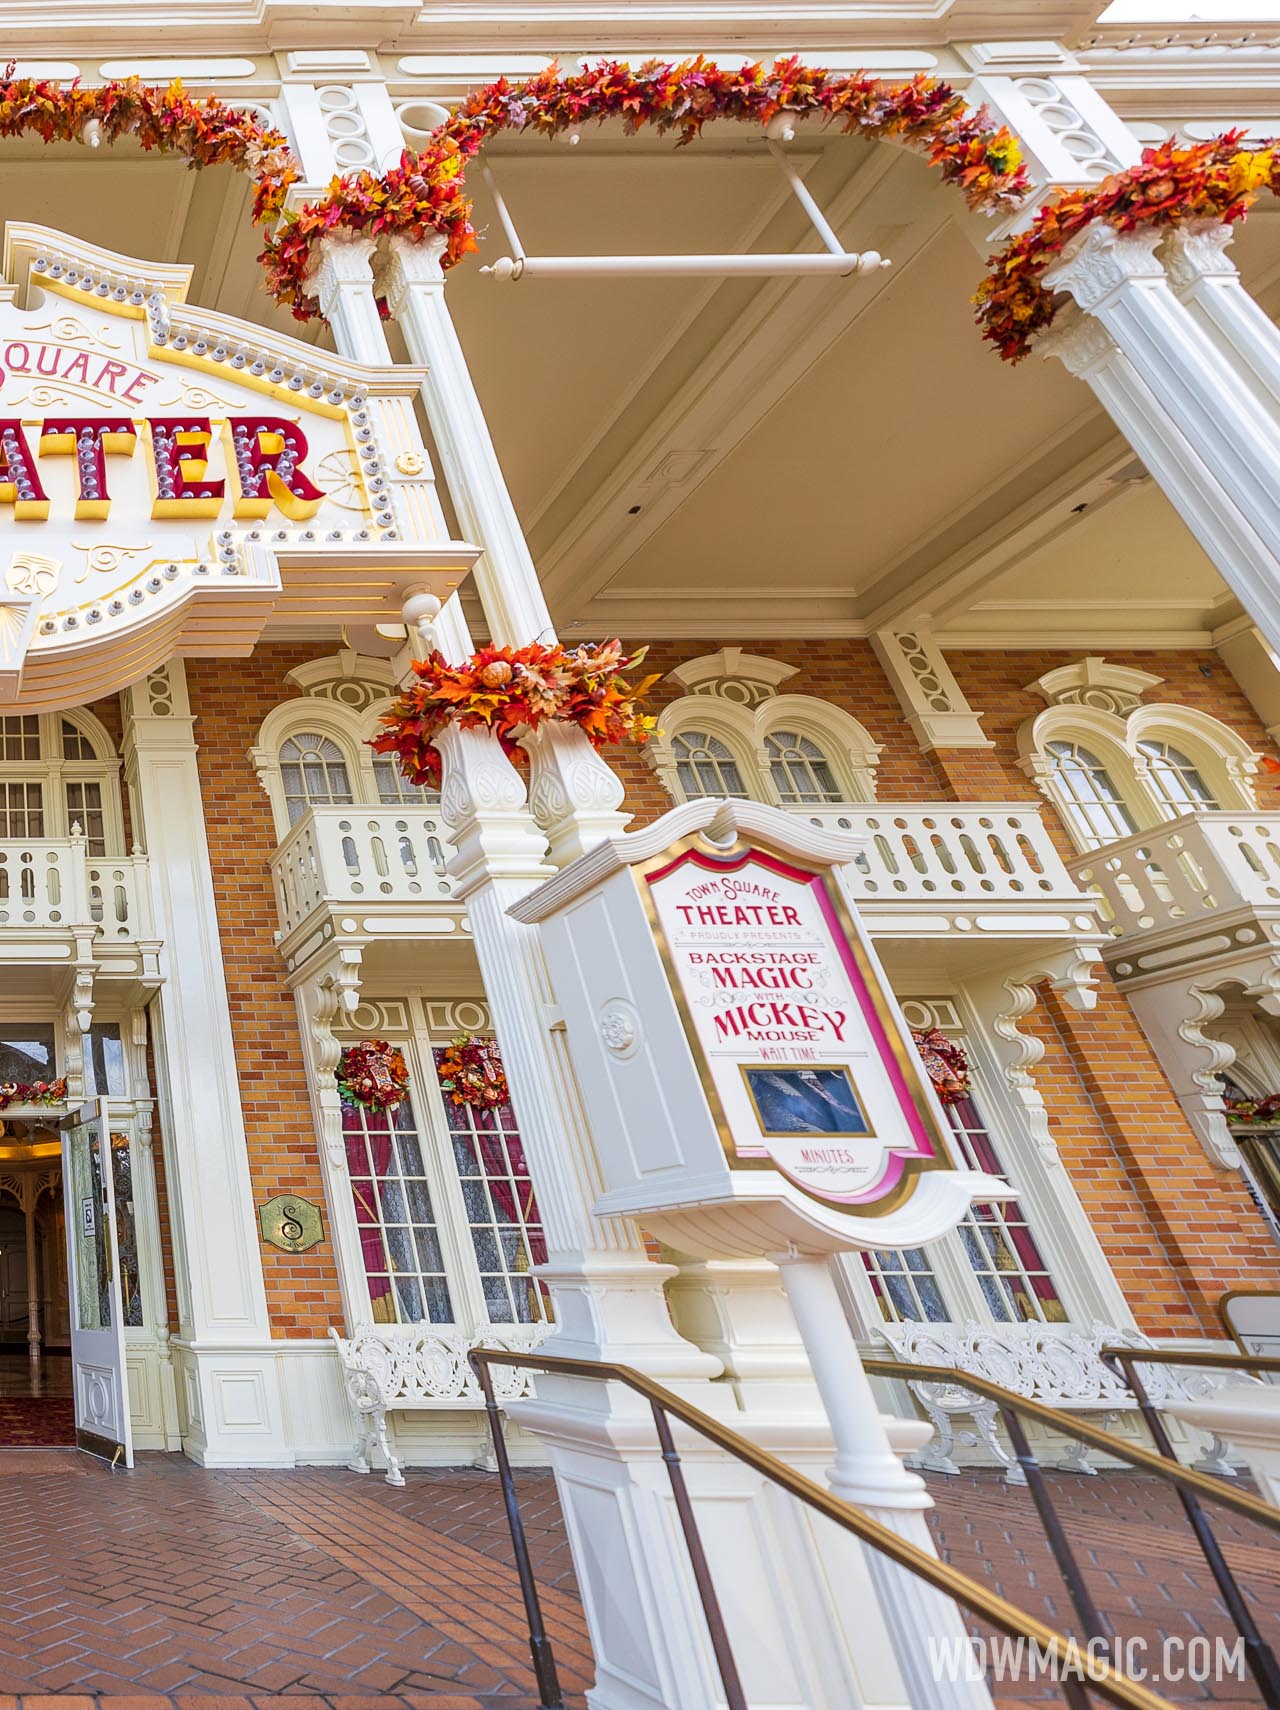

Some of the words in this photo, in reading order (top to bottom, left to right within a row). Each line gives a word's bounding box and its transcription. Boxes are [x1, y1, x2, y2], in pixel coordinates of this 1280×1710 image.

[685, 880, 720, 902] TOWN
[721, 877, 781, 904] SQUARE
[676, 905, 803, 926] THEATER
[690, 931, 739, 940] PROUDLY
[743, 931, 801, 940] PRESENTS
[688, 952, 822, 965] BACKSTAGE
[711, 967, 814, 989] MAGIC
[754, 992, 785, 1001] WITH
[713, 1002, 846, 1044] MICKEY
[747, 1030, 821, 1042] MOUSE
[759, 1047, 787, 1061] WAIT
[789, 1047, 820, 1061] TIME
[800, 1149, 855, 1164] MINUTES
[281, 1205, 304, 1240] S
